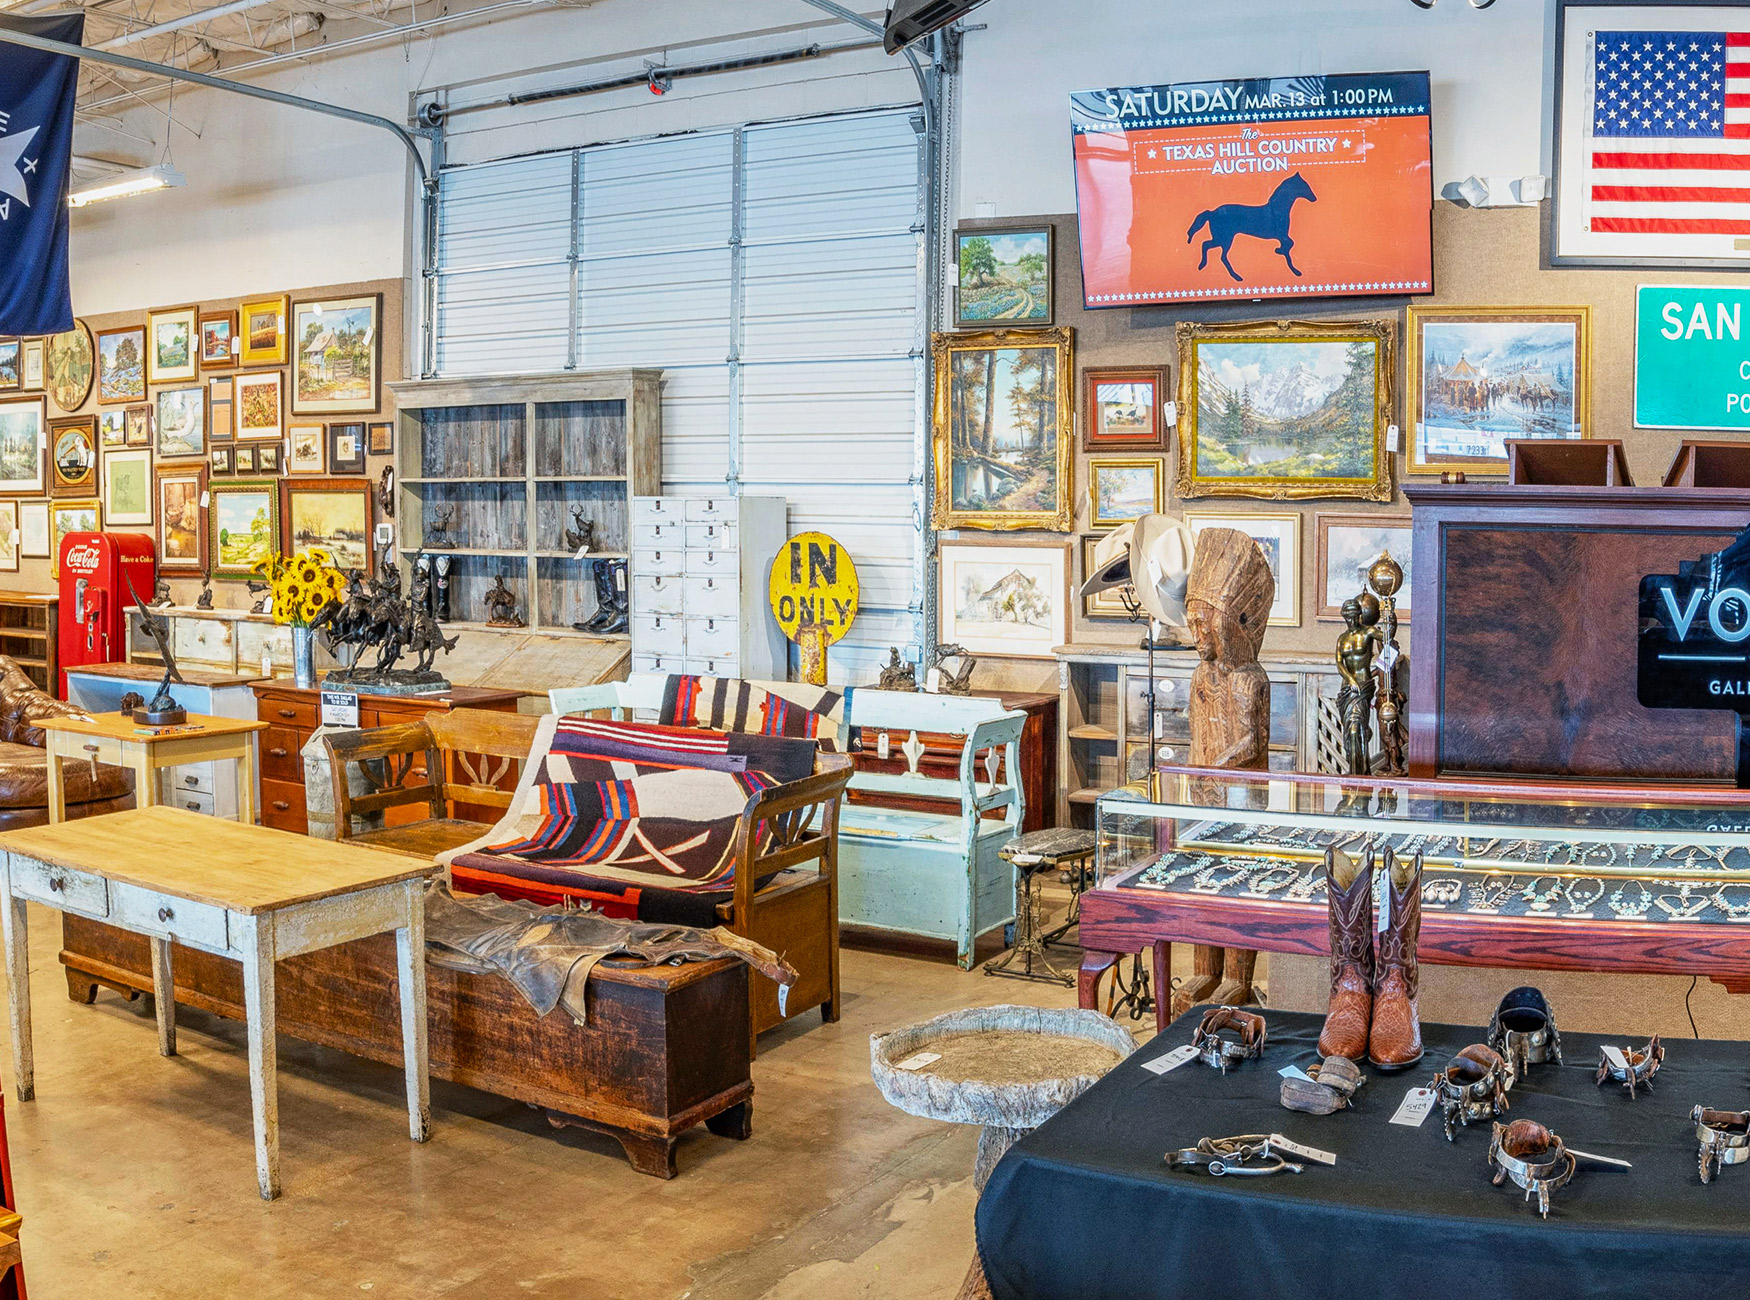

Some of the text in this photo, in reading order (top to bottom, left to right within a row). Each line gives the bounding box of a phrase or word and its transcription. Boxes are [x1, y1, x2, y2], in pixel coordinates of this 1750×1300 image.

[1105, 87, 1393, 119] SATURDAY MAR. 13 at 1:00 PM
[1241, 128, 1258, 140] The
[1163, 138, 1337, 161] TEXAS HILL COUNTRY
[1211, 157, 1288, 175] AUCTION
[1660, 301, 1741, 341] SAN
[120, 555, 134, 563] Have
[140, 555, 154, 563] Coke
[790, 542, 837, 588] IN
[779, 594, 852, 626] ONLY
